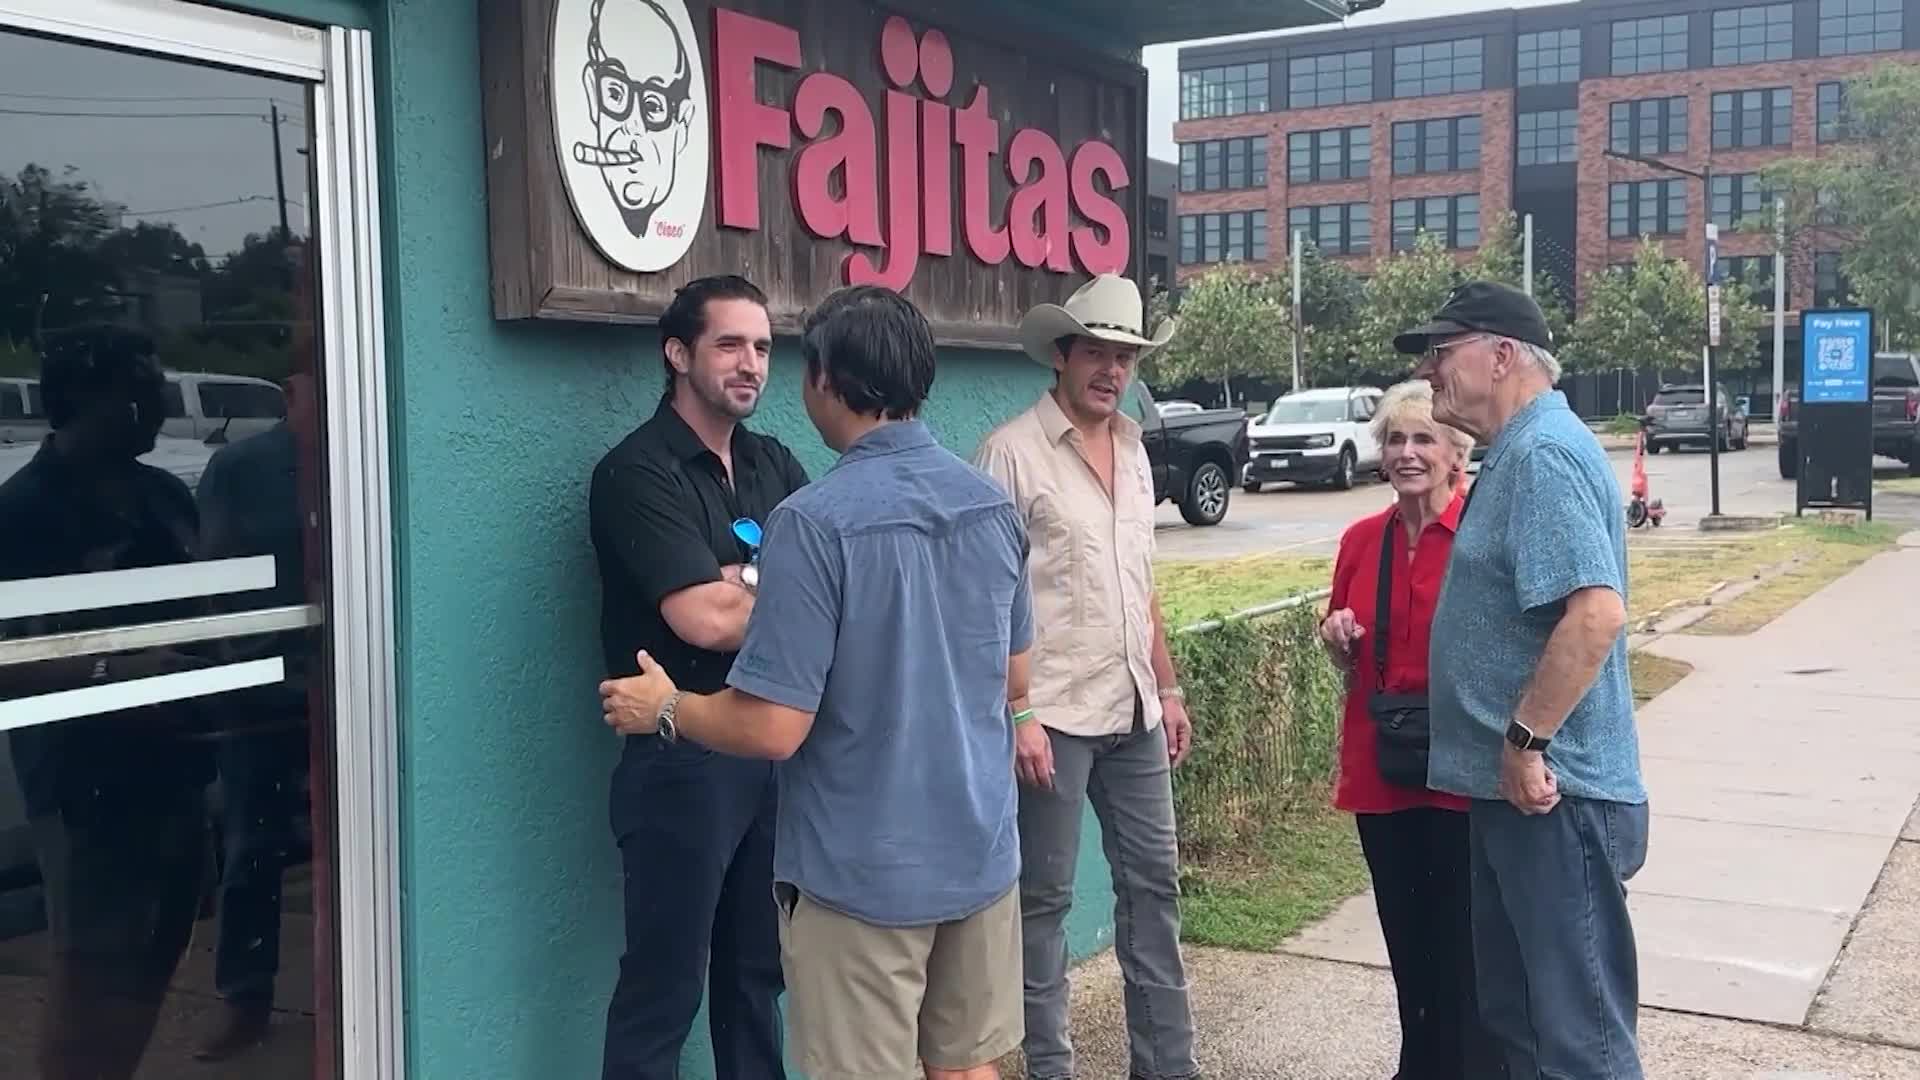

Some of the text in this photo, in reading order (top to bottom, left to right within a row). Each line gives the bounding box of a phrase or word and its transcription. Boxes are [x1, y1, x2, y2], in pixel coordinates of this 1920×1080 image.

[715, 7, 1131, 291] Fajitas
[1813, 319, 1861, 329] Pay Here
